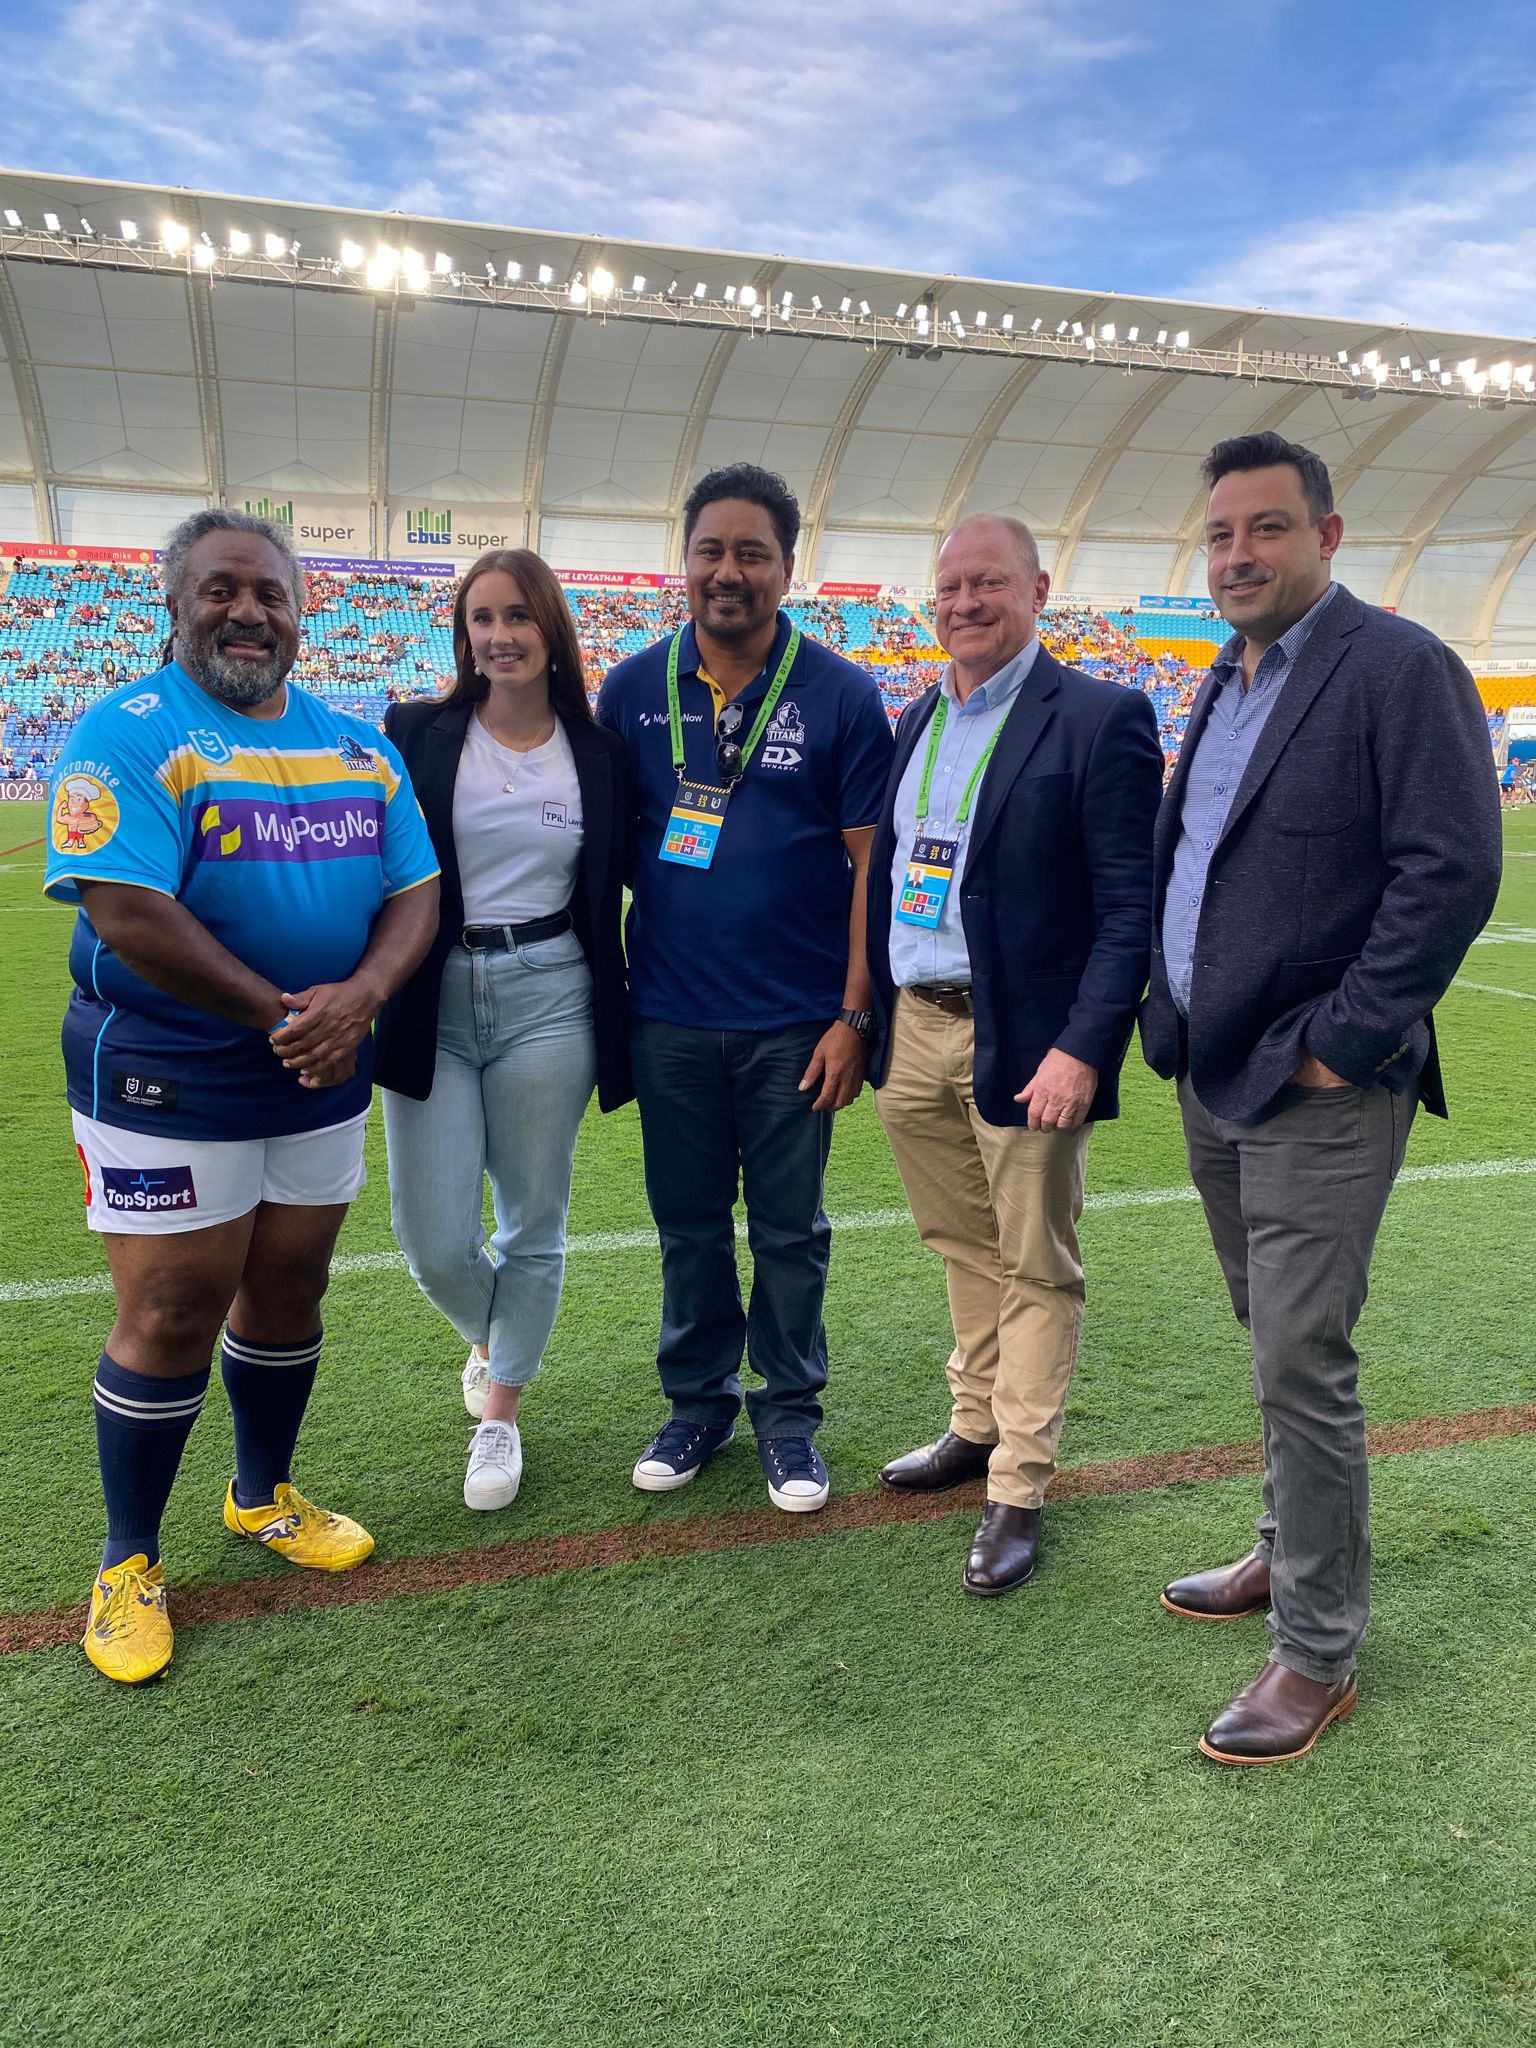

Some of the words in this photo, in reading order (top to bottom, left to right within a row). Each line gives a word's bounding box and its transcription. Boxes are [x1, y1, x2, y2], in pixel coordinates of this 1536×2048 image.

[300, 525, 355, 542] super
[407, 527, 451, 544] cbus
[457, 533, 508, 549] super
[13, 547, 58, 556] macromike
[87, 551, 132, 560] macromike
[554, 572, 570, 580] THE
[572, 573, 624, 582] LEVIATHAN
[664, 577, 687, 586] RIDE
[789, 582, 808, 591] AVS
[889, 586, 906, 595] AVS
[1047, 594, 1091, 602] ALERNOLAW
[768, 678, 783, 703] FIELD
[780, 664, 788, 675] OF
[785, 642, 797, 662] PLAY
[653, 713, 703, 725] MyPNow
[933, 711, 944, 737] FIELD
[769, 730, 802, 742] TITANS
[344, 760, 379, 773] TITANS
[760, 763, 799, 773] DYNASTY
[254, 810, 380, 852] MyPayNo
[931, 845, 940, 853] 20
[106, 1188, 191, 1210] TopSport
